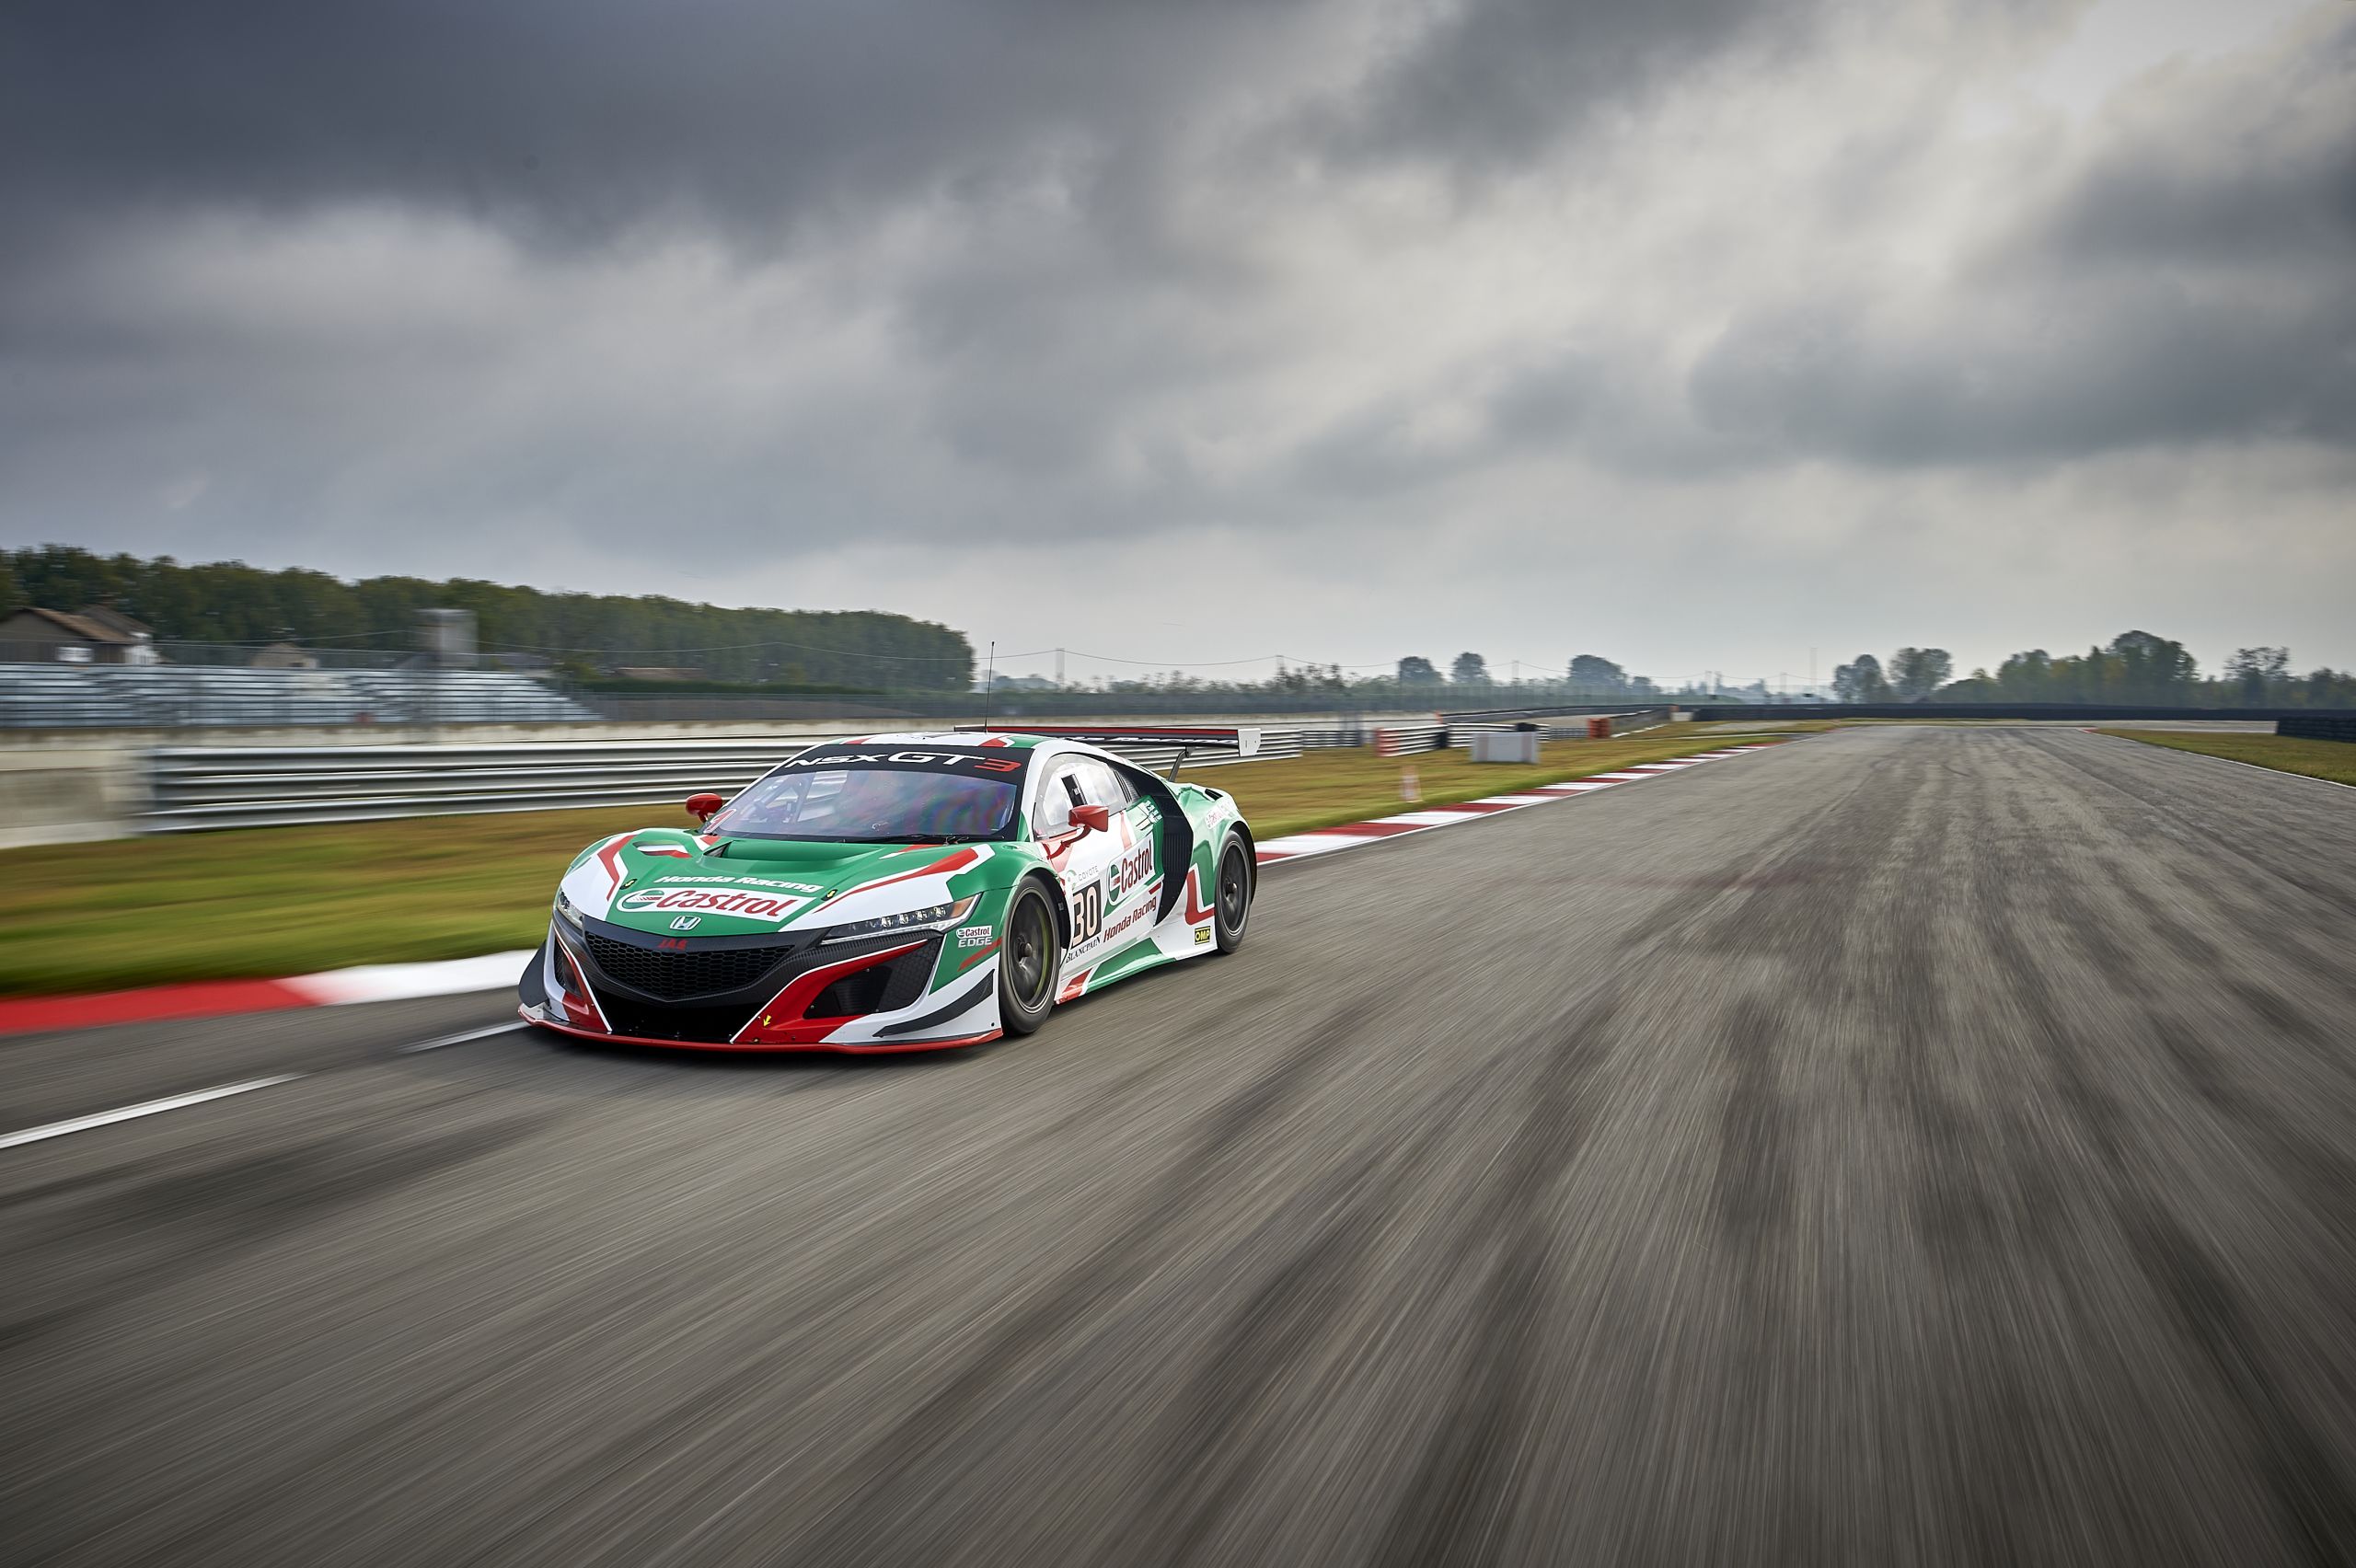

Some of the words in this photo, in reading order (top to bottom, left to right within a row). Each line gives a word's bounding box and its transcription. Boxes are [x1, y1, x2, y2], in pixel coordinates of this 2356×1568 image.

[784, 754, 889, 768] NSX
[888, 751, 1022, 772] GT3
[1078, 865, 1099, 882] COYOTE
[1121, 840, 1153, 894] Castrol
[653, 875, 735, 884] Honda
[734, 876, 825, 894] Racing
[656, 890, 798, 917] Castrol
[1072, 885, 1098, 946] 30
[1103, 914, 1133, 943] Honda
[1132, 896, 1157, 923] Racing
[958, 936, 993, 948] EDGE
[964, 927, 990, 937] Castrol
[1195, 929, 1210, 941] OMP
